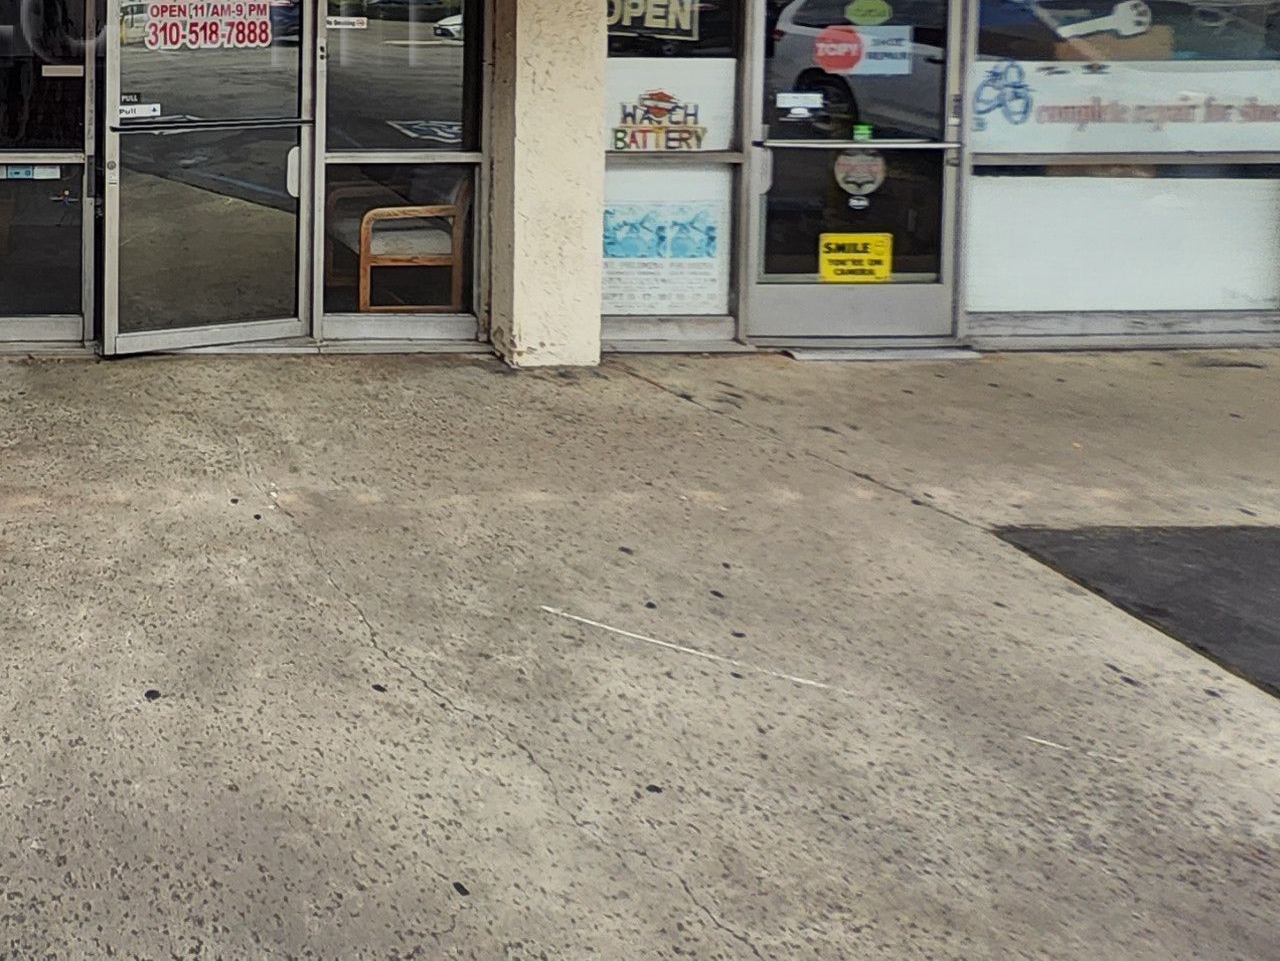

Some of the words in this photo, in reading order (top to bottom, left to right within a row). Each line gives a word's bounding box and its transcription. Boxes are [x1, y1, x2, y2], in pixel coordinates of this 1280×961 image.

[150, 5, 187, 18] OPEN
[193, 5, 205, 17] 11
[248, 3, 267, 16] PM
[148, 20, 269, 47] 310-518-7888
[613, 126, 707, 150] BATTERY
[822, 243, 872, 254] SMILE
